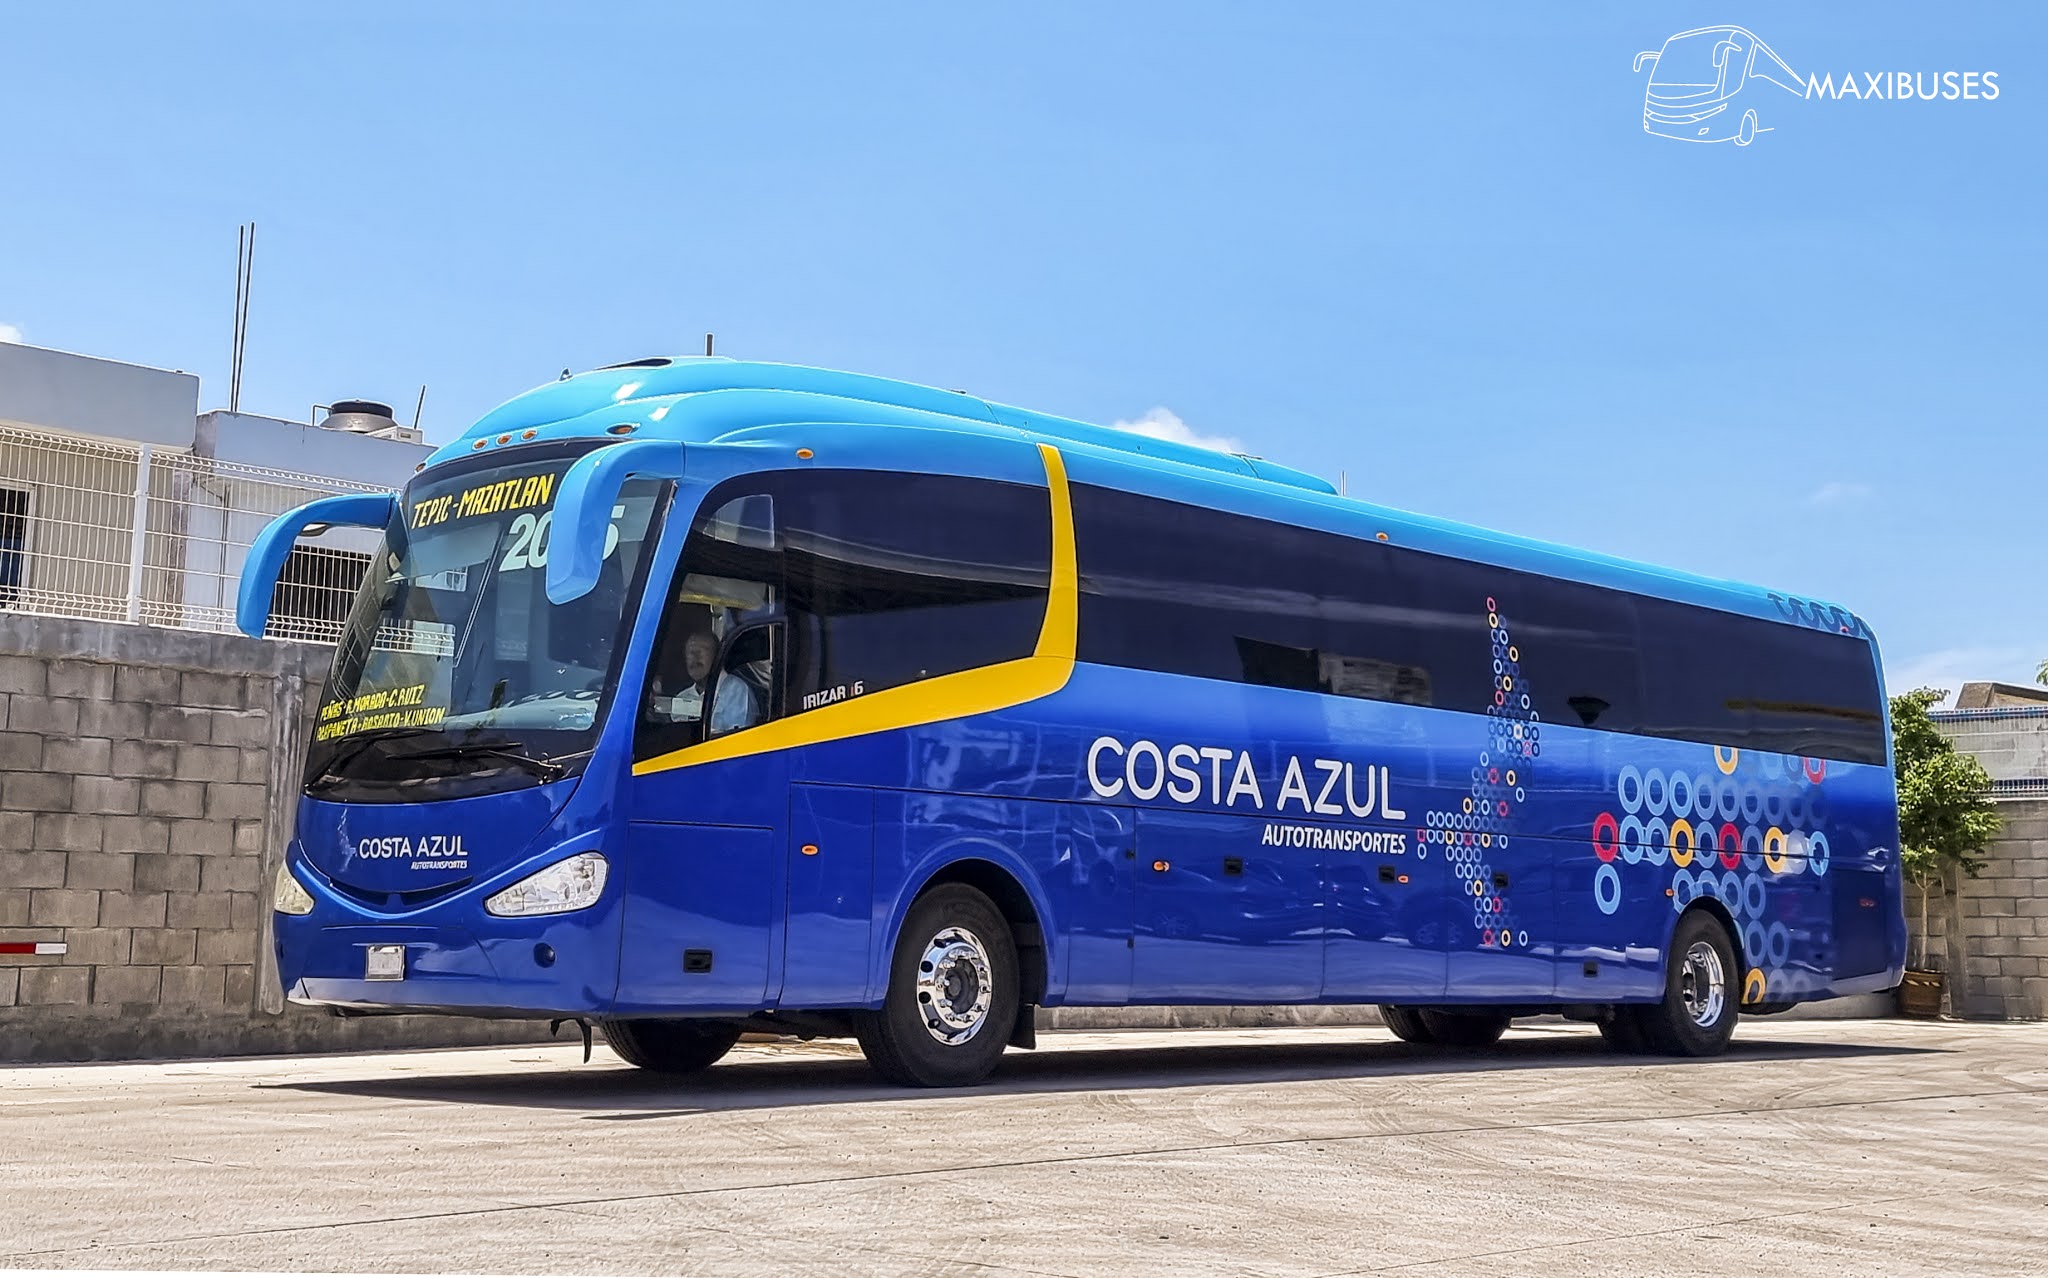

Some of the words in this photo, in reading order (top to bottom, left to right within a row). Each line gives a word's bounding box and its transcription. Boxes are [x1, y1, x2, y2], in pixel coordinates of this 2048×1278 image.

[803, 685, 846, 710] IRIZAR
[1087, 735, 1264, 810] COSTA
[1276, 755, 1407, 821] AZUL
[359, 836, 412, 859] COSTA
[416, 835, 468, 858] AZUL
[1261, 824, 1407, 856] AUTOTRANSPORTES
[410, 860, 468, 871] AUTOTRANSPORTES
